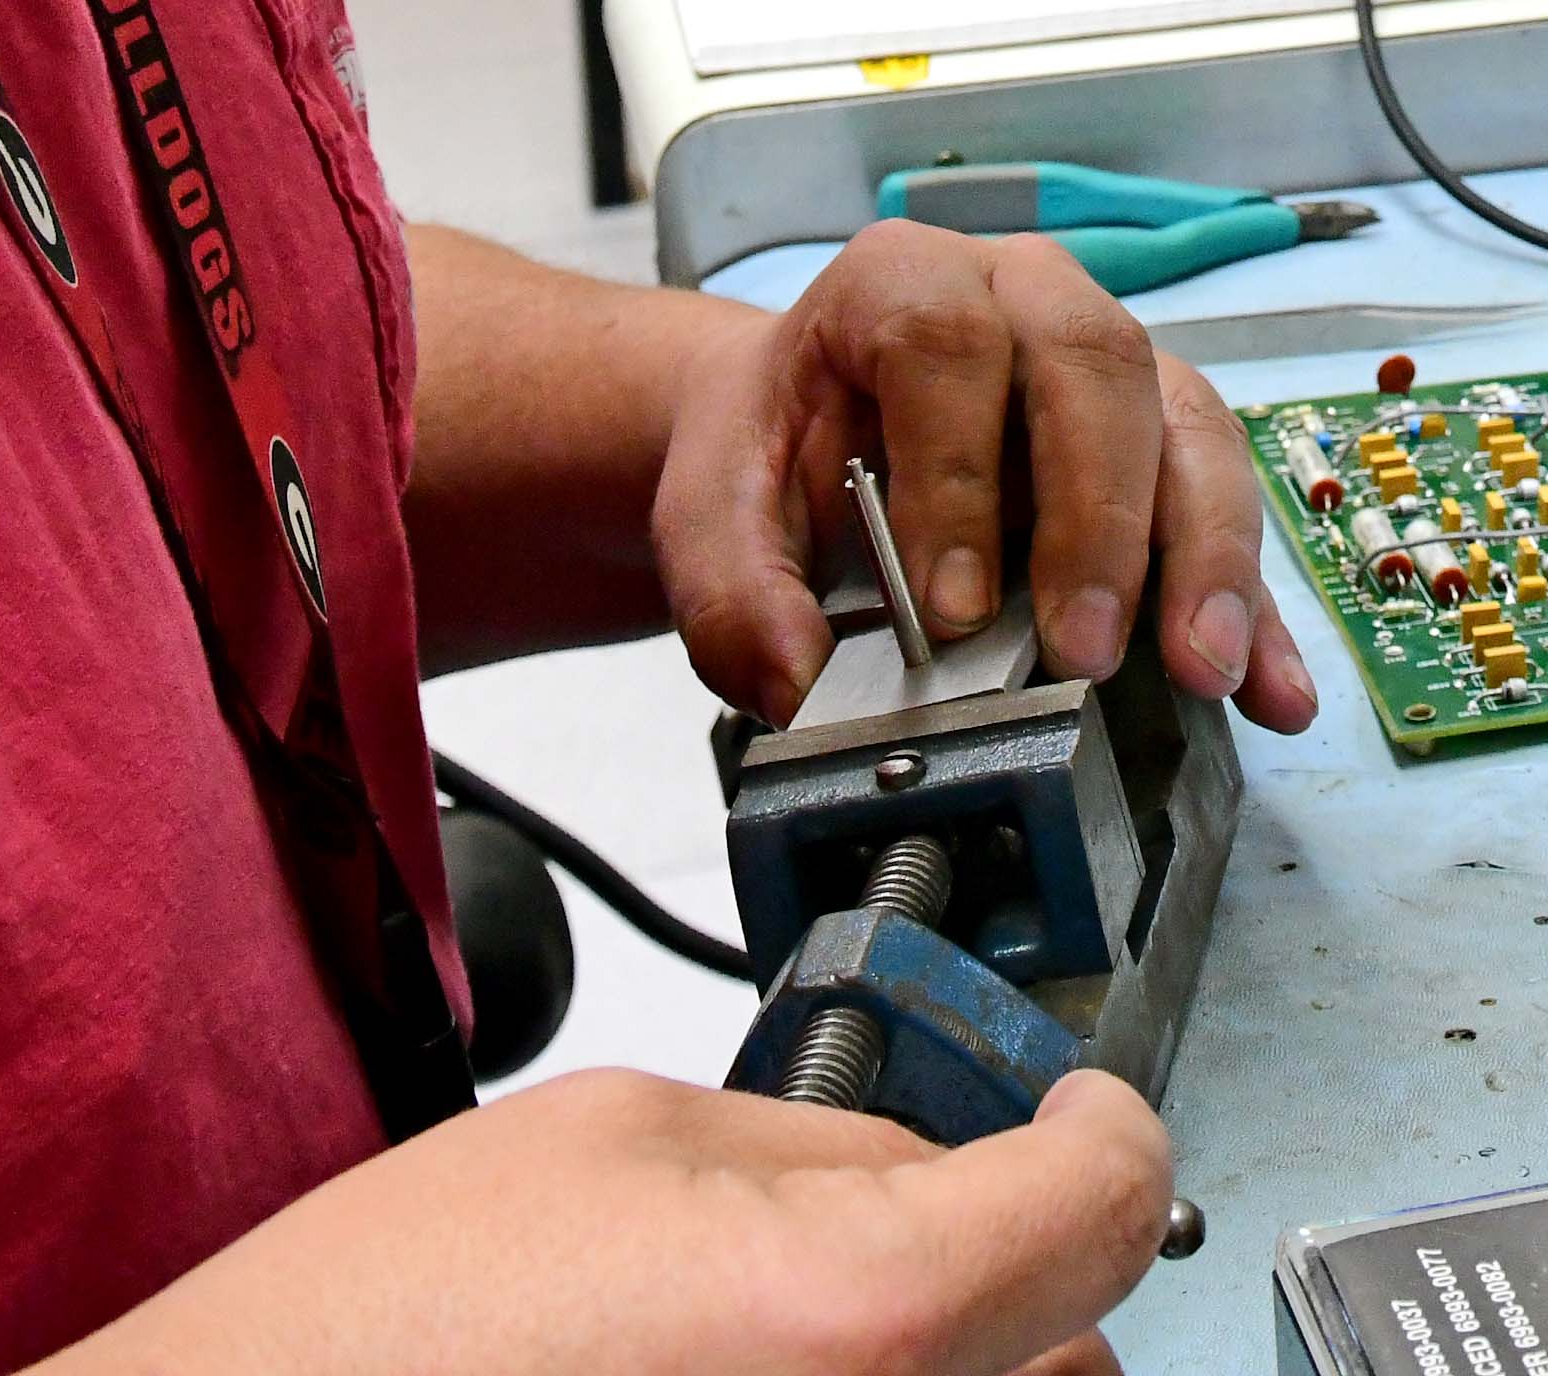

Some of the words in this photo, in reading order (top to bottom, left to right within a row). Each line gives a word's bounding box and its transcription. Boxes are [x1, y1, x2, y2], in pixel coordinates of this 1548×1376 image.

[1416, 1248, 1480, 1332] 6993-0077
[1476, 1260, 1540, 1348] 6993-0082
[1391, 1300, 1453, 1376] 993-0037
[1462, 1336, 1505, 1376] CED
